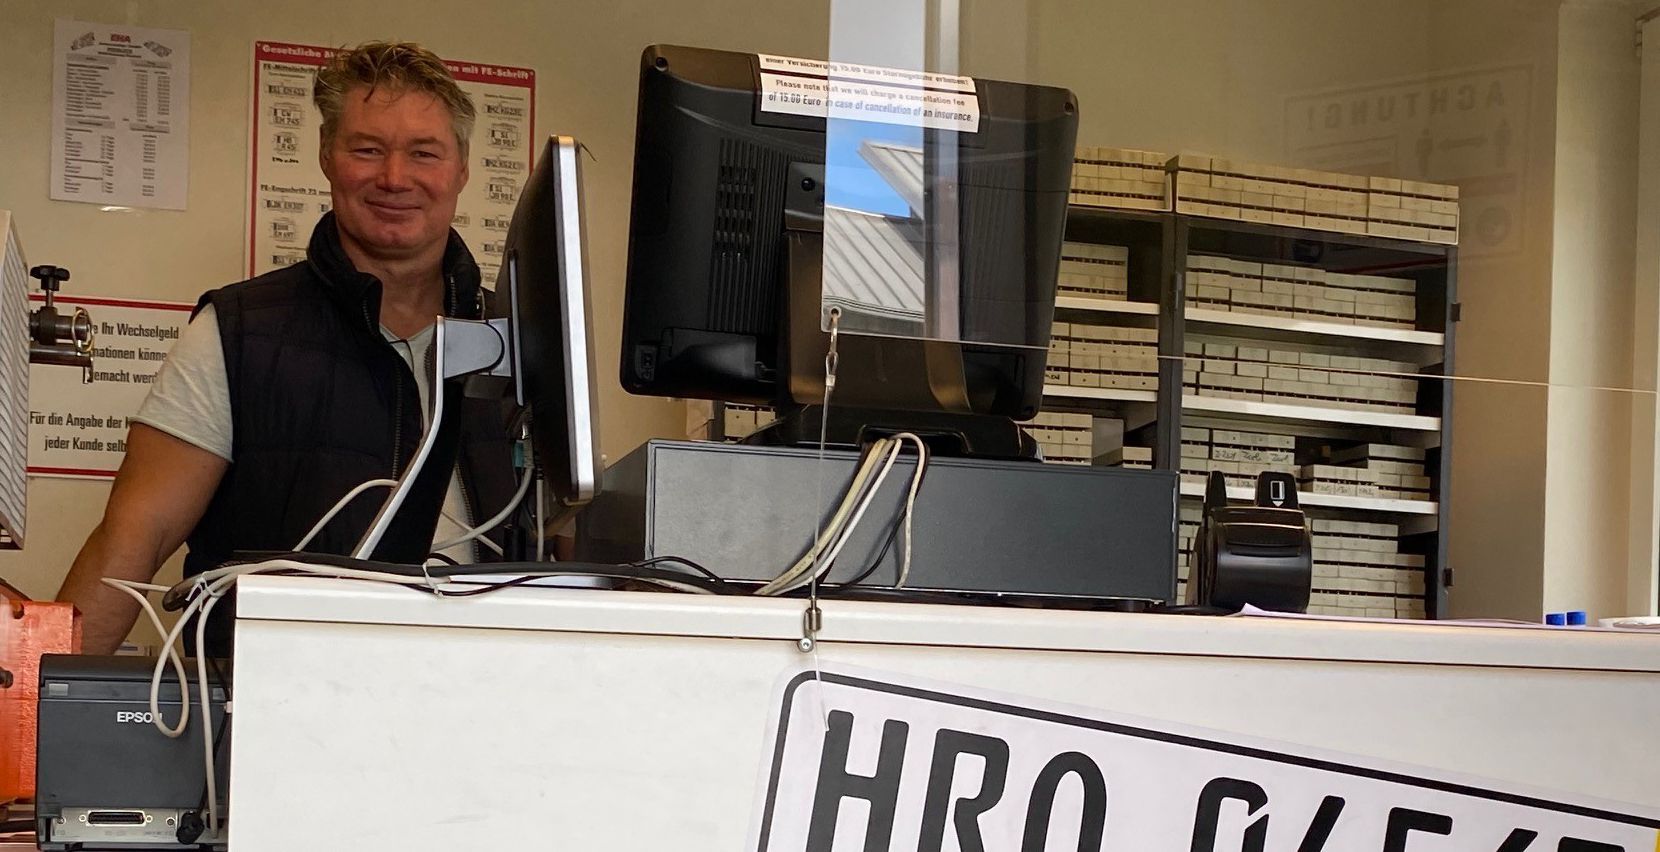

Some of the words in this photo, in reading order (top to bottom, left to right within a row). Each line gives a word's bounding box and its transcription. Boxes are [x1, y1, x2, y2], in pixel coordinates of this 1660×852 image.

[262, 44, 322, 58] Gesetzliche
[462, 66, 479, 75] mit
[481, 67, 530, 80] FE-Schrift
[776, 79, 802, 89] Please
[804, 83, 821, 91] note
[822, 85, 839, 93] that
[854, 87, 869, 96] will
[870, 88, 897, 99] charge
[906, 93, 952, 105] cancellation
[768, 91, 777, 102] of
[803, 94, 822, 106] Euro
[826, 98, 834, 107] in
[836, 99, 853, 109] case
[855, 100, 864, 110] of
[865, 102, 912, 116] cancellation
[913, 106, 923, 117] of
[923, 109, 933, 118] an
[101, 321, 115, 335] Ihr
[116, 322, 180, 341] Wechselgeld
[138, 347, 168, 362] könne
[93, 369, 131, 383] emacht
[29, 410, 46, 425] Für
[47, 412, 63, 426] die
[65, 412, 104, 430] Angabe
[106, 415, 123, 429] der
[44, 435, 70, 452] jeder
[72, 436, 104, 452] Kunde
